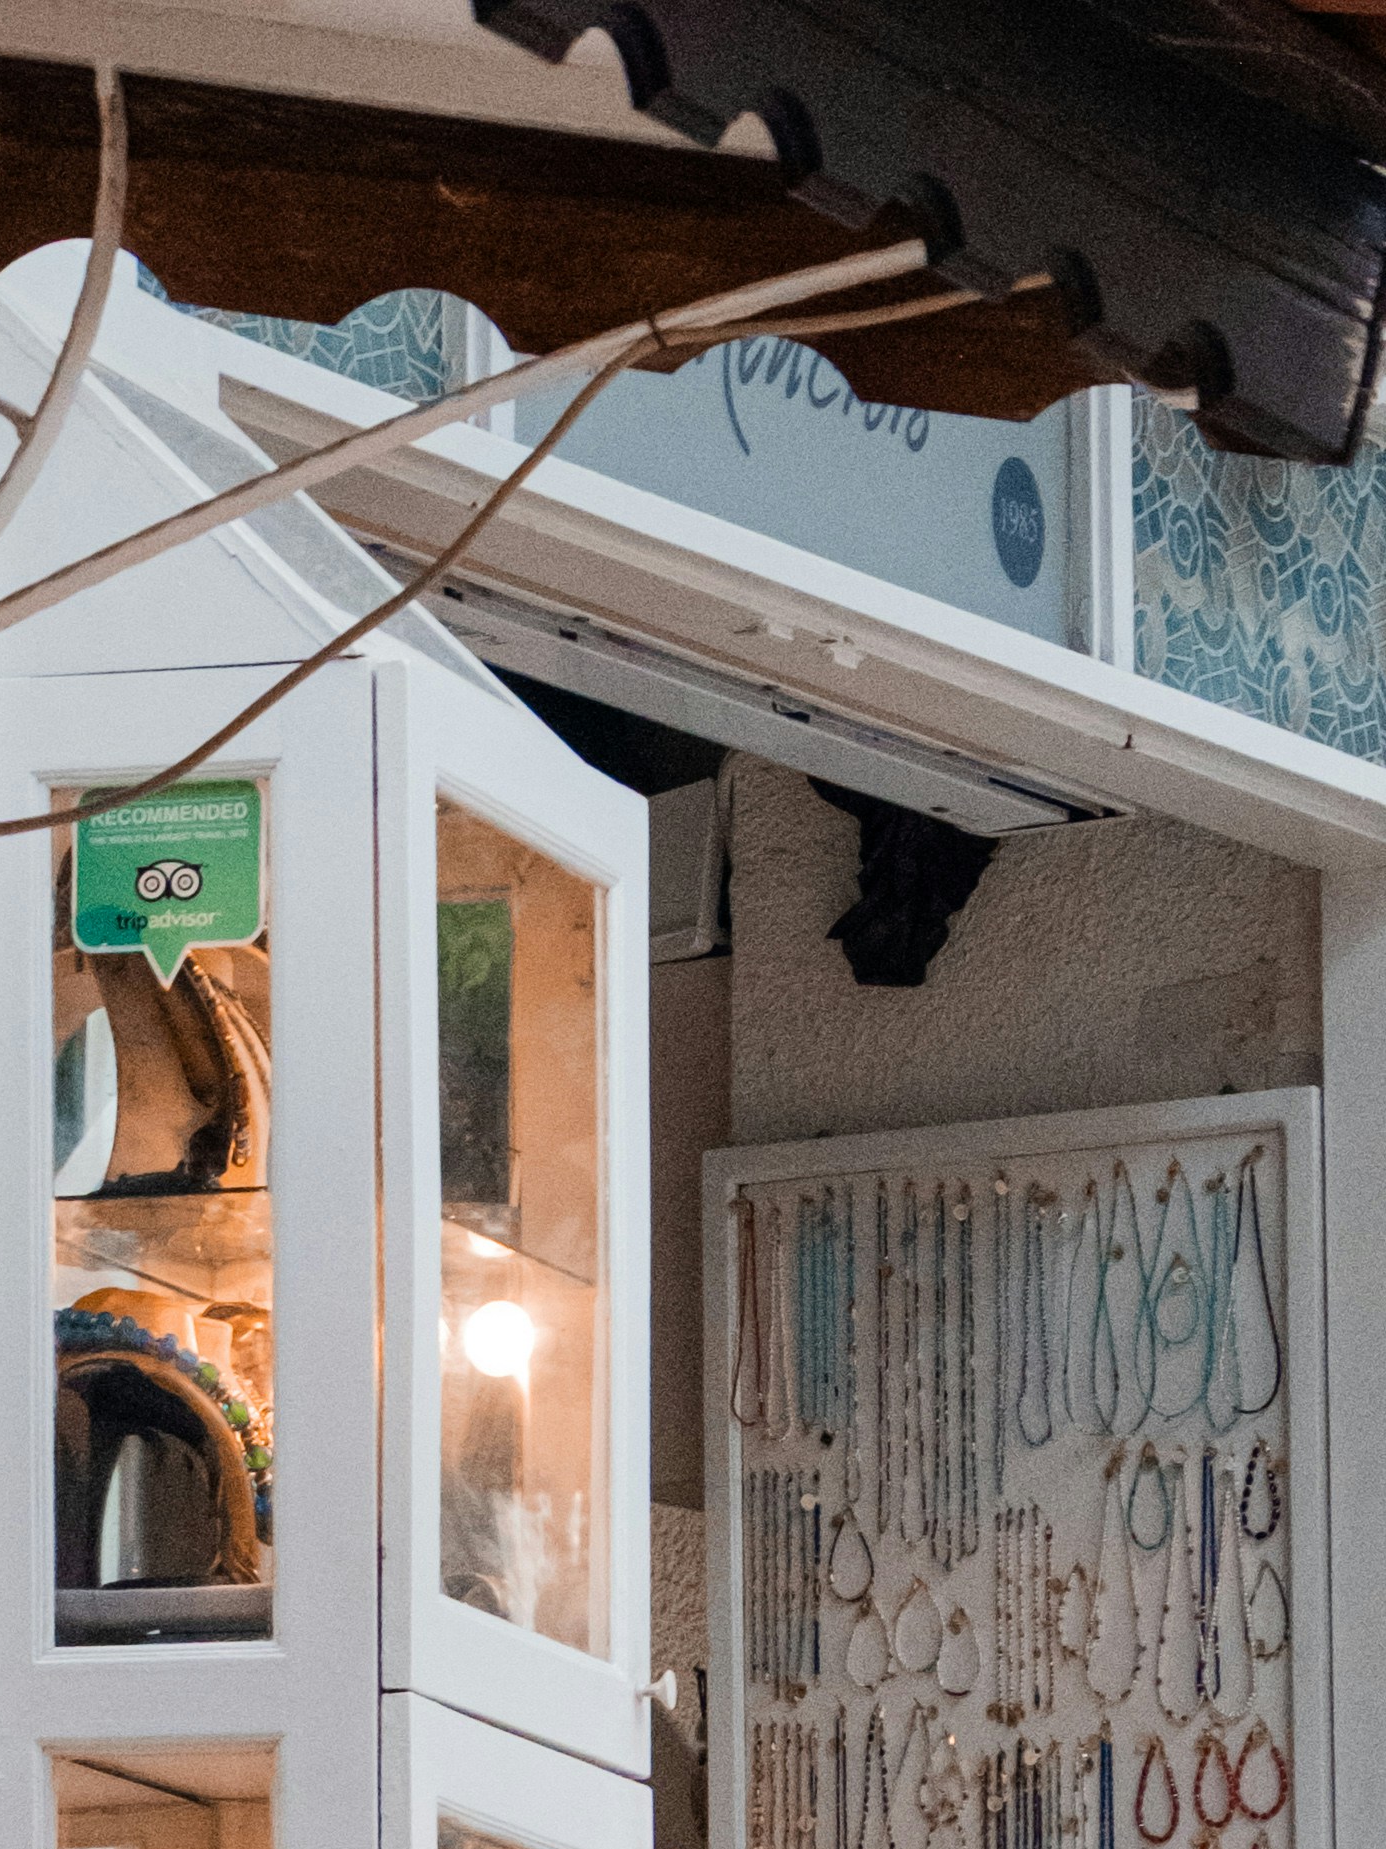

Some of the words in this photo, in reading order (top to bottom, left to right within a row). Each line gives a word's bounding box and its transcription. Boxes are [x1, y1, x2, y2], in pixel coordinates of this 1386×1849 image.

[1000, 497, 1038, 543] 1985
[90, 802, 248, 827] RECOMMENDED
[116, 910, 215, 930] tripadvisor
